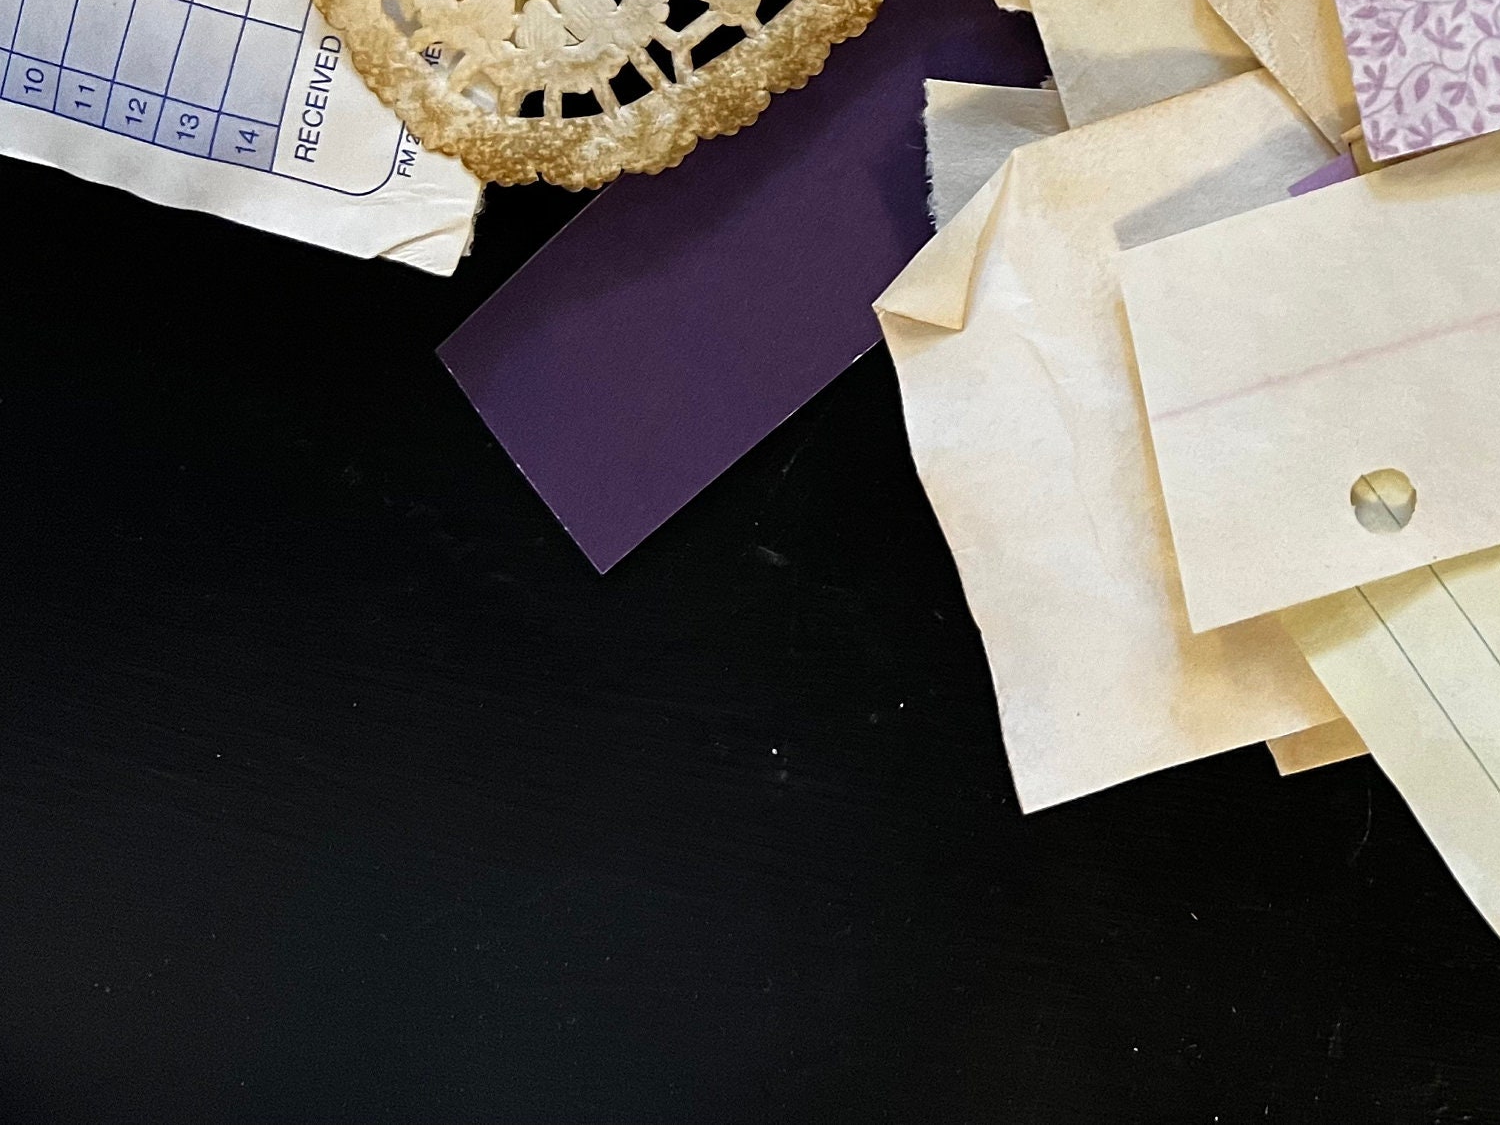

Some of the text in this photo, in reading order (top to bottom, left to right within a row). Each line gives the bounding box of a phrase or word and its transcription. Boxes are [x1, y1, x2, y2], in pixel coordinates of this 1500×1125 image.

[23, 68, 44, 94] 10
[75, 84, 95, 109] 11
[294, 35, 342, 163] RECEIVED
[125, 97, 147, 125] 12
[176, 113, 200, 140] 13
[235, 129, 260, 154] 14
[396, 149, 417, 177] FM
